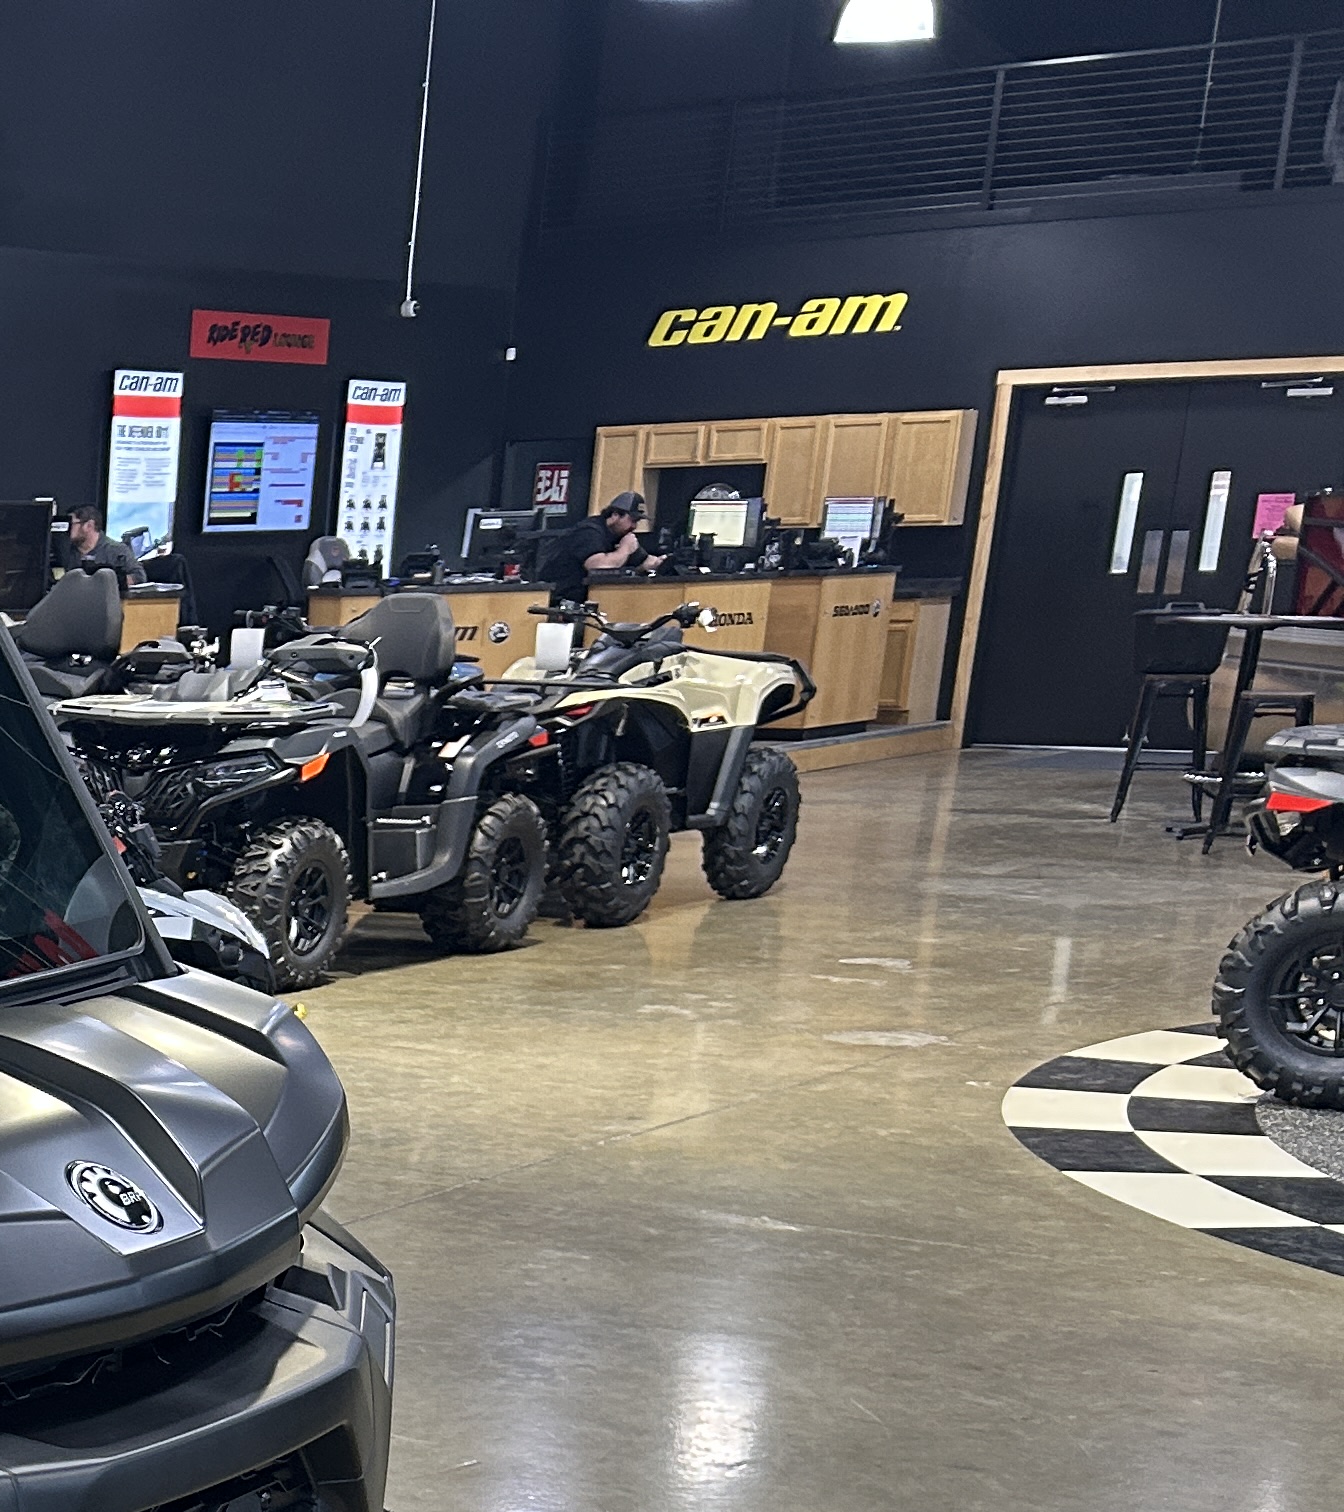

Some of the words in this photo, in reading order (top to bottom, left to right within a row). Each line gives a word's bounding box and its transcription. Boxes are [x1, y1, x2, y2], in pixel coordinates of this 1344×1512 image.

[648, 292, 909, 347] can-am
[118, 374, 179, 393] can-am
[352, 386, 402, 402] can-am
